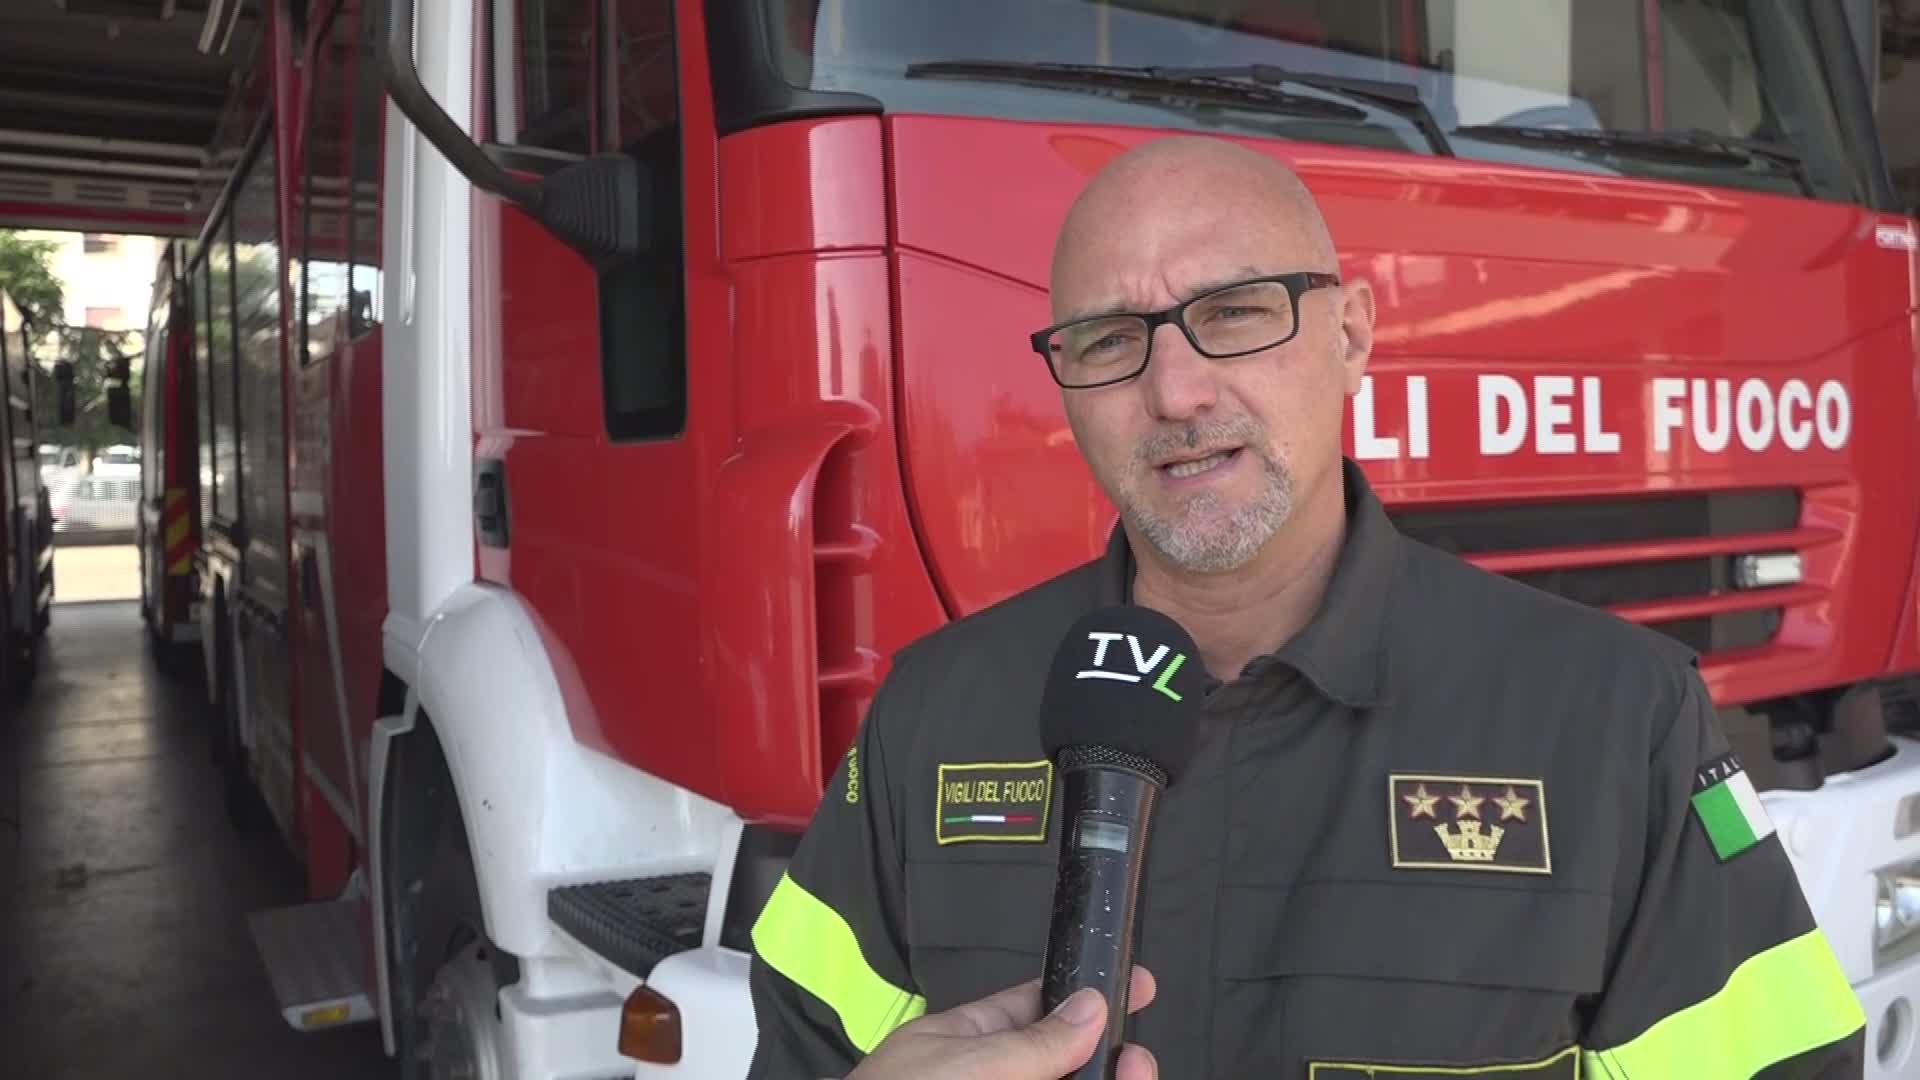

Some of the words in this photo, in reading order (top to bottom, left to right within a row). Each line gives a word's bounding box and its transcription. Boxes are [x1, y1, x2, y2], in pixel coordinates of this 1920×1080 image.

[1477, 374, 1621, 455] DEL
[1651, 377, 1851, 452] FUOCO
[1087, 631, 1187, 701] TVL
[944, 781, 976, 804] VIGILI
[976, 780, 1001, 803] DEL
[1002, 778, 1045, 803] FUOCO
